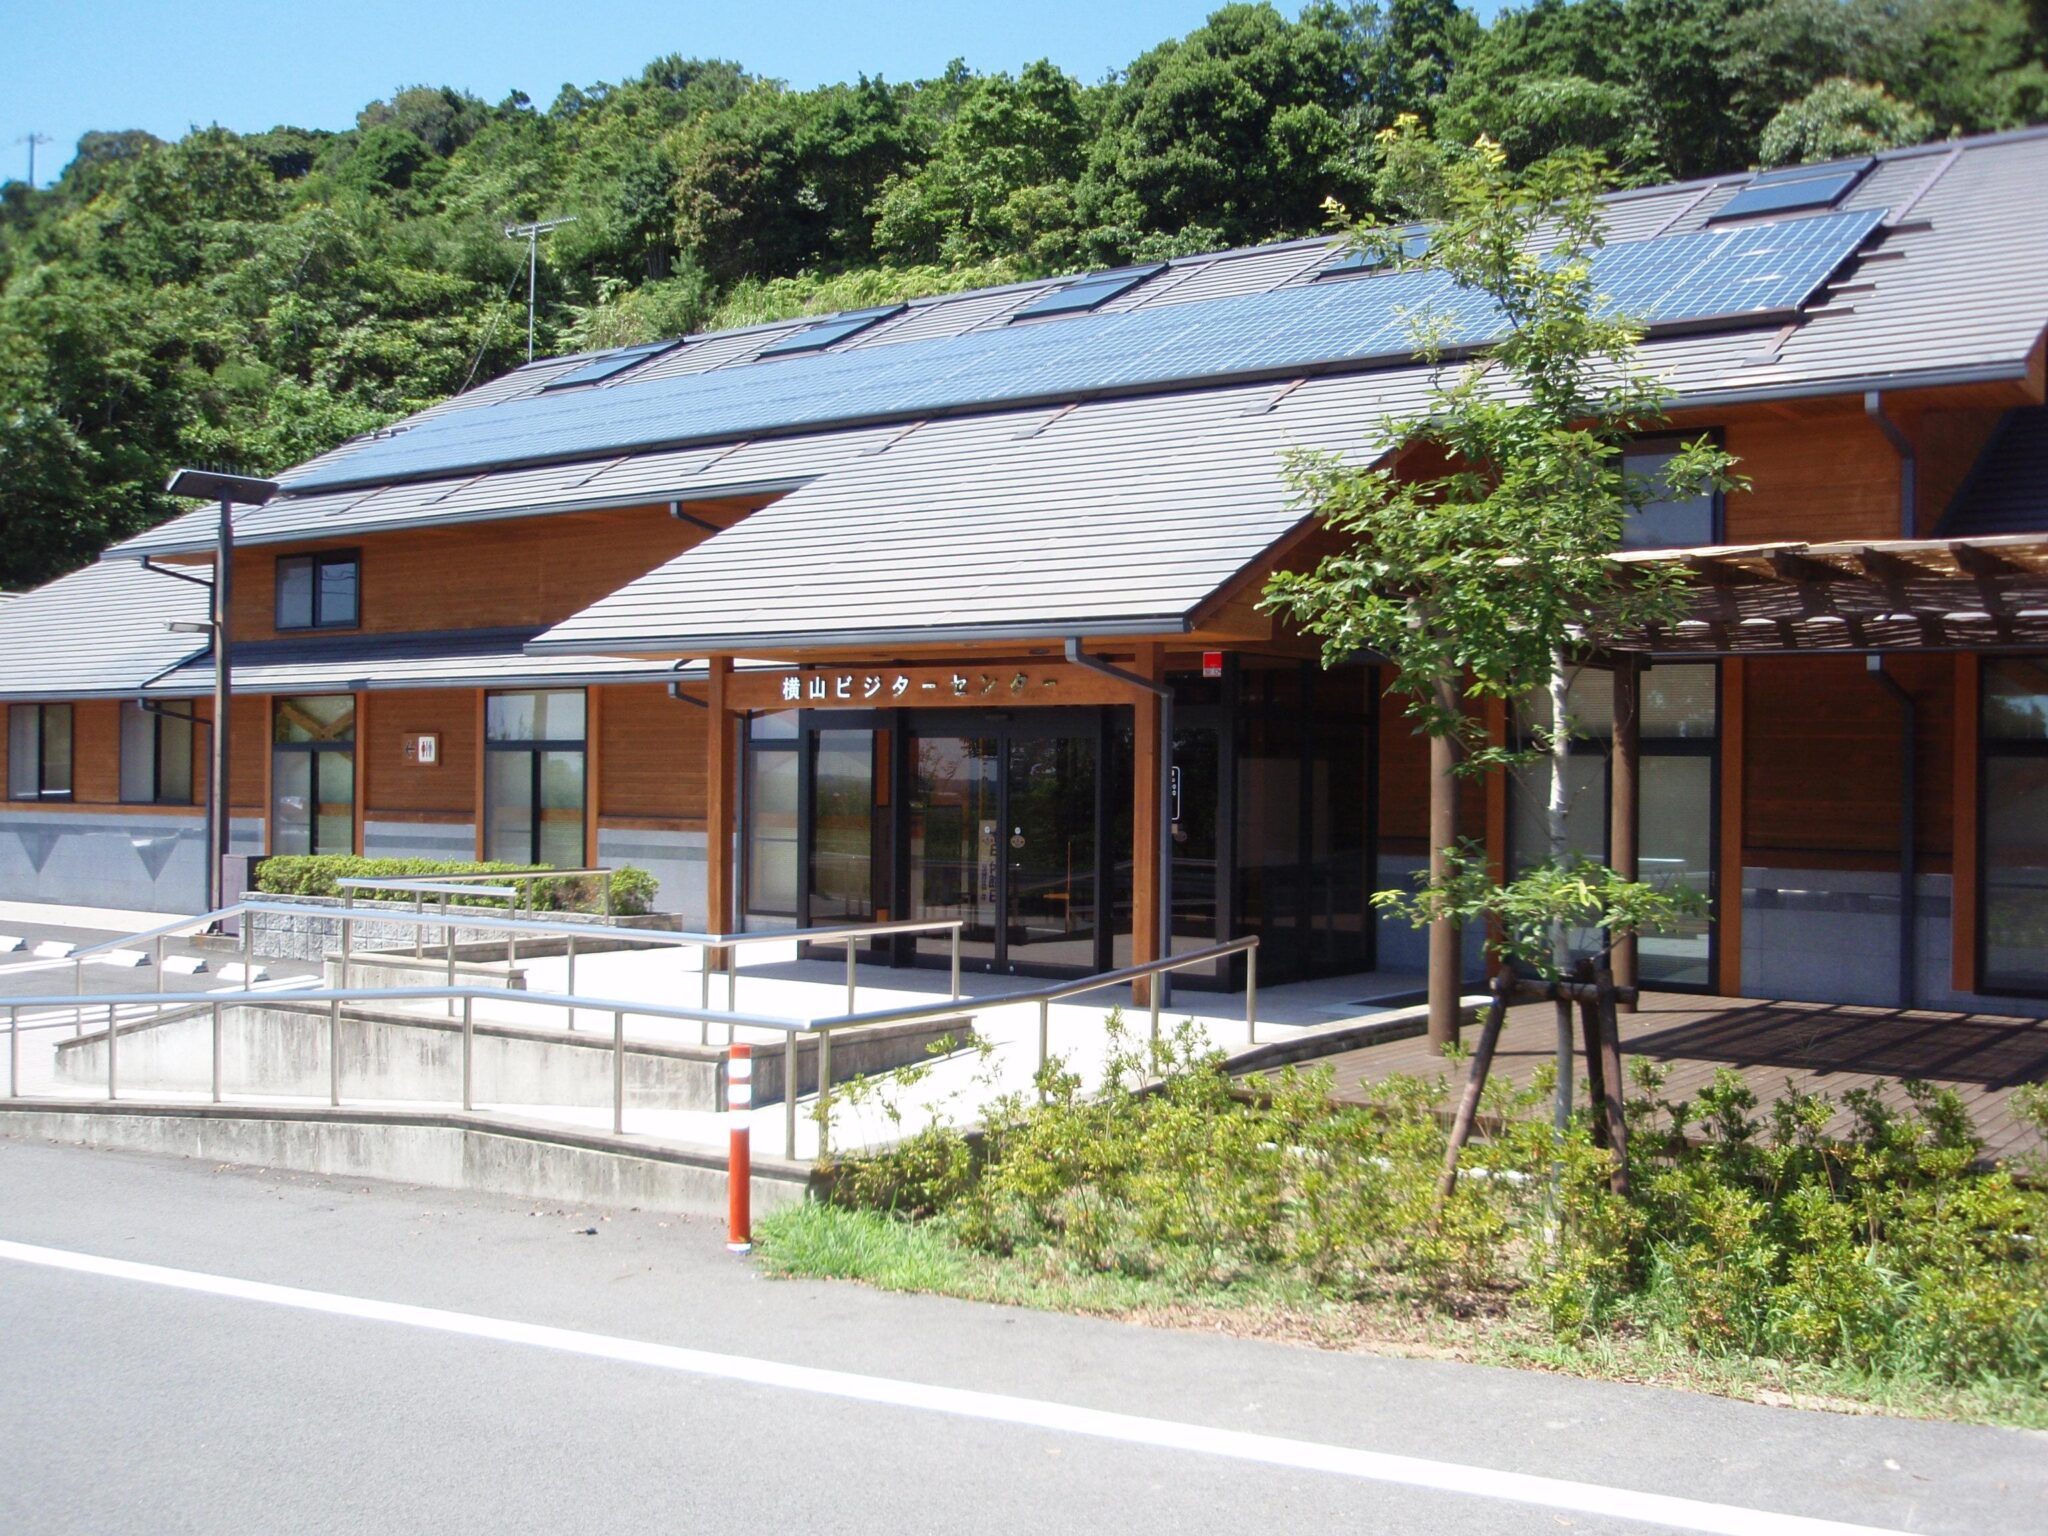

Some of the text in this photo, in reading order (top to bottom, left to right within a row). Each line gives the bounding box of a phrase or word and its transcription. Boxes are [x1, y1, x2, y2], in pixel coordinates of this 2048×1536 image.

[782, 674, 1056, 700] 横山ビジターセンター
